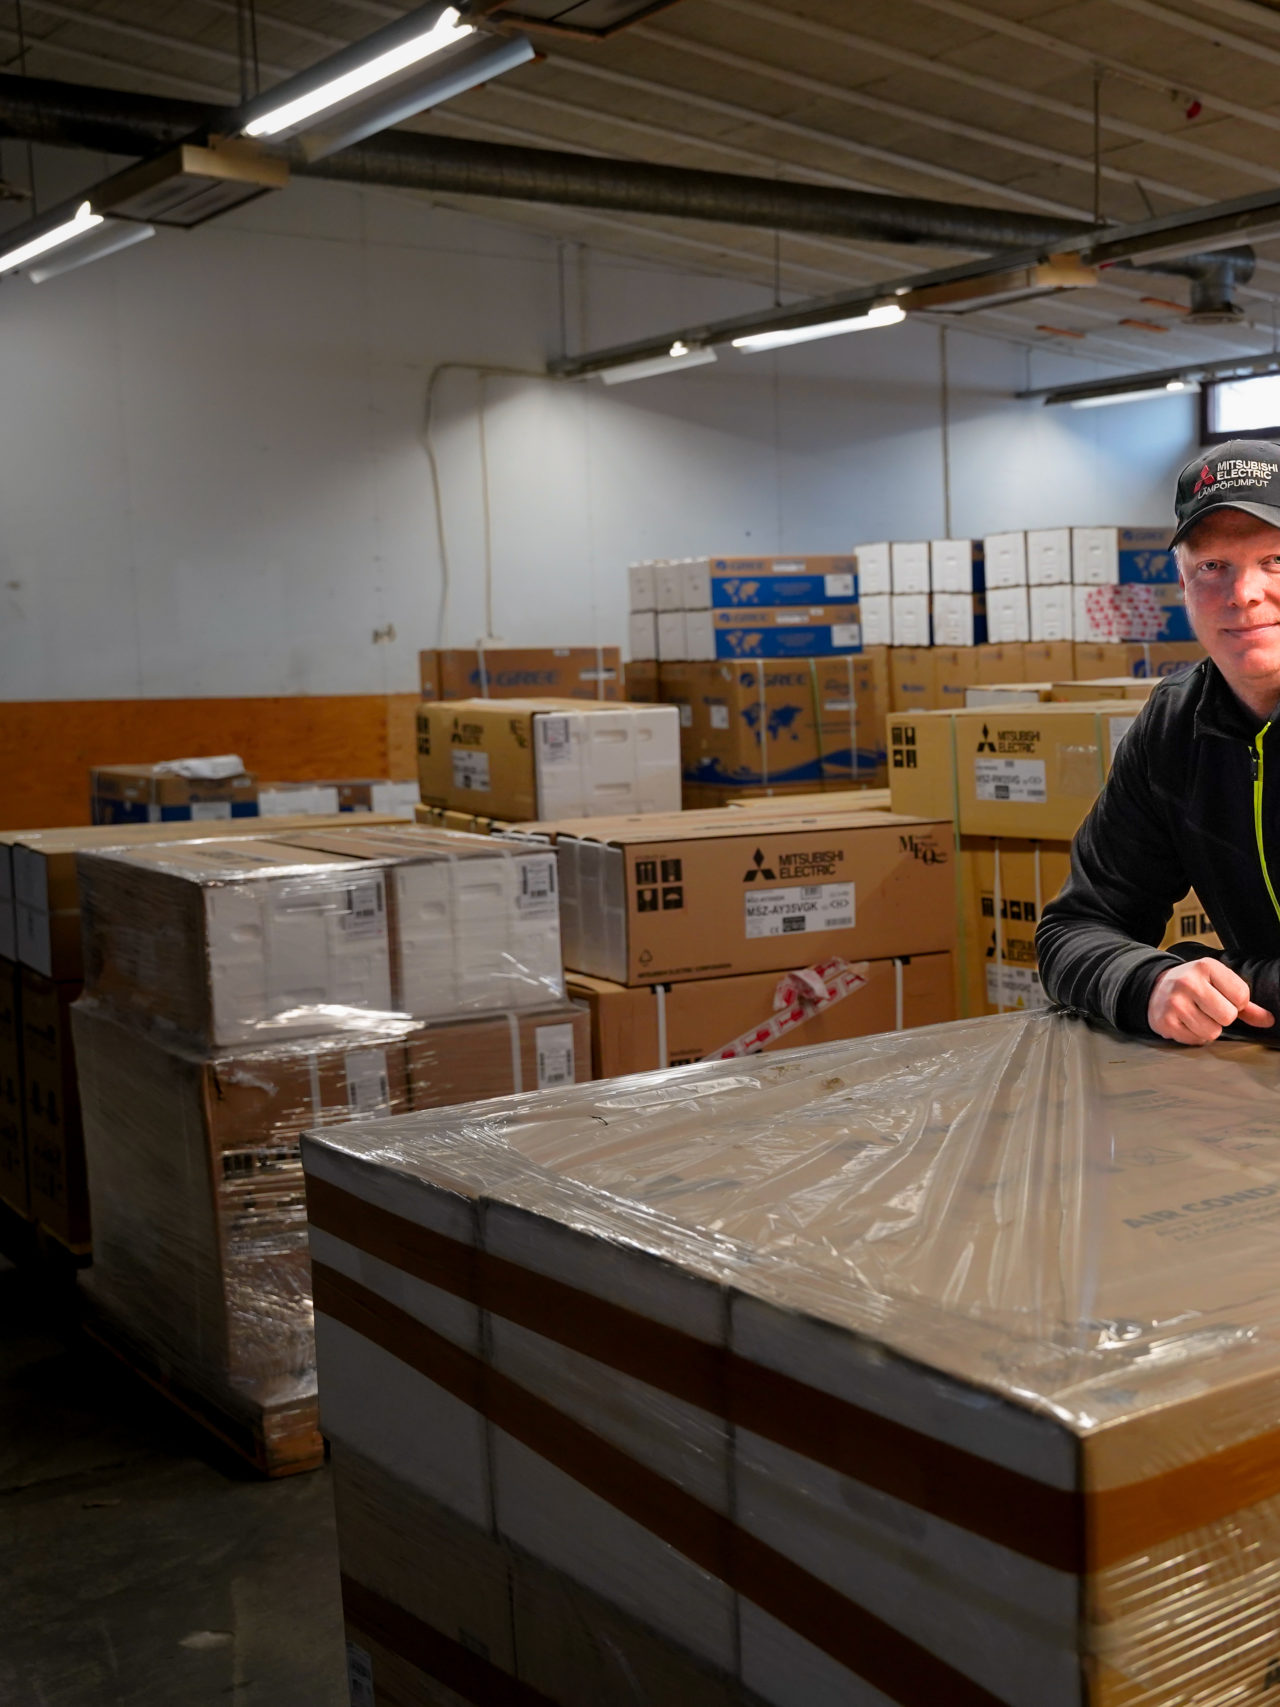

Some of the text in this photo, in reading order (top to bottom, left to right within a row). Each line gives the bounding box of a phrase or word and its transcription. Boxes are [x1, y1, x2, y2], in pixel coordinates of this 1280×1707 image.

[1216, 468, 1272, 481] ELECTRIC
[1217, 459, 1279, 473] MITSUBISHI
[1197, 478, 1269, 499] LÄMPÖPUMPUT
[997, 731, 1040, 742] MITSUBISHI
[778, 850, 844, 867] MITSUBISHI
[778, 863, 837, 880] ELECTRIC
[1123, 1208, 1187, 1230] AIR
